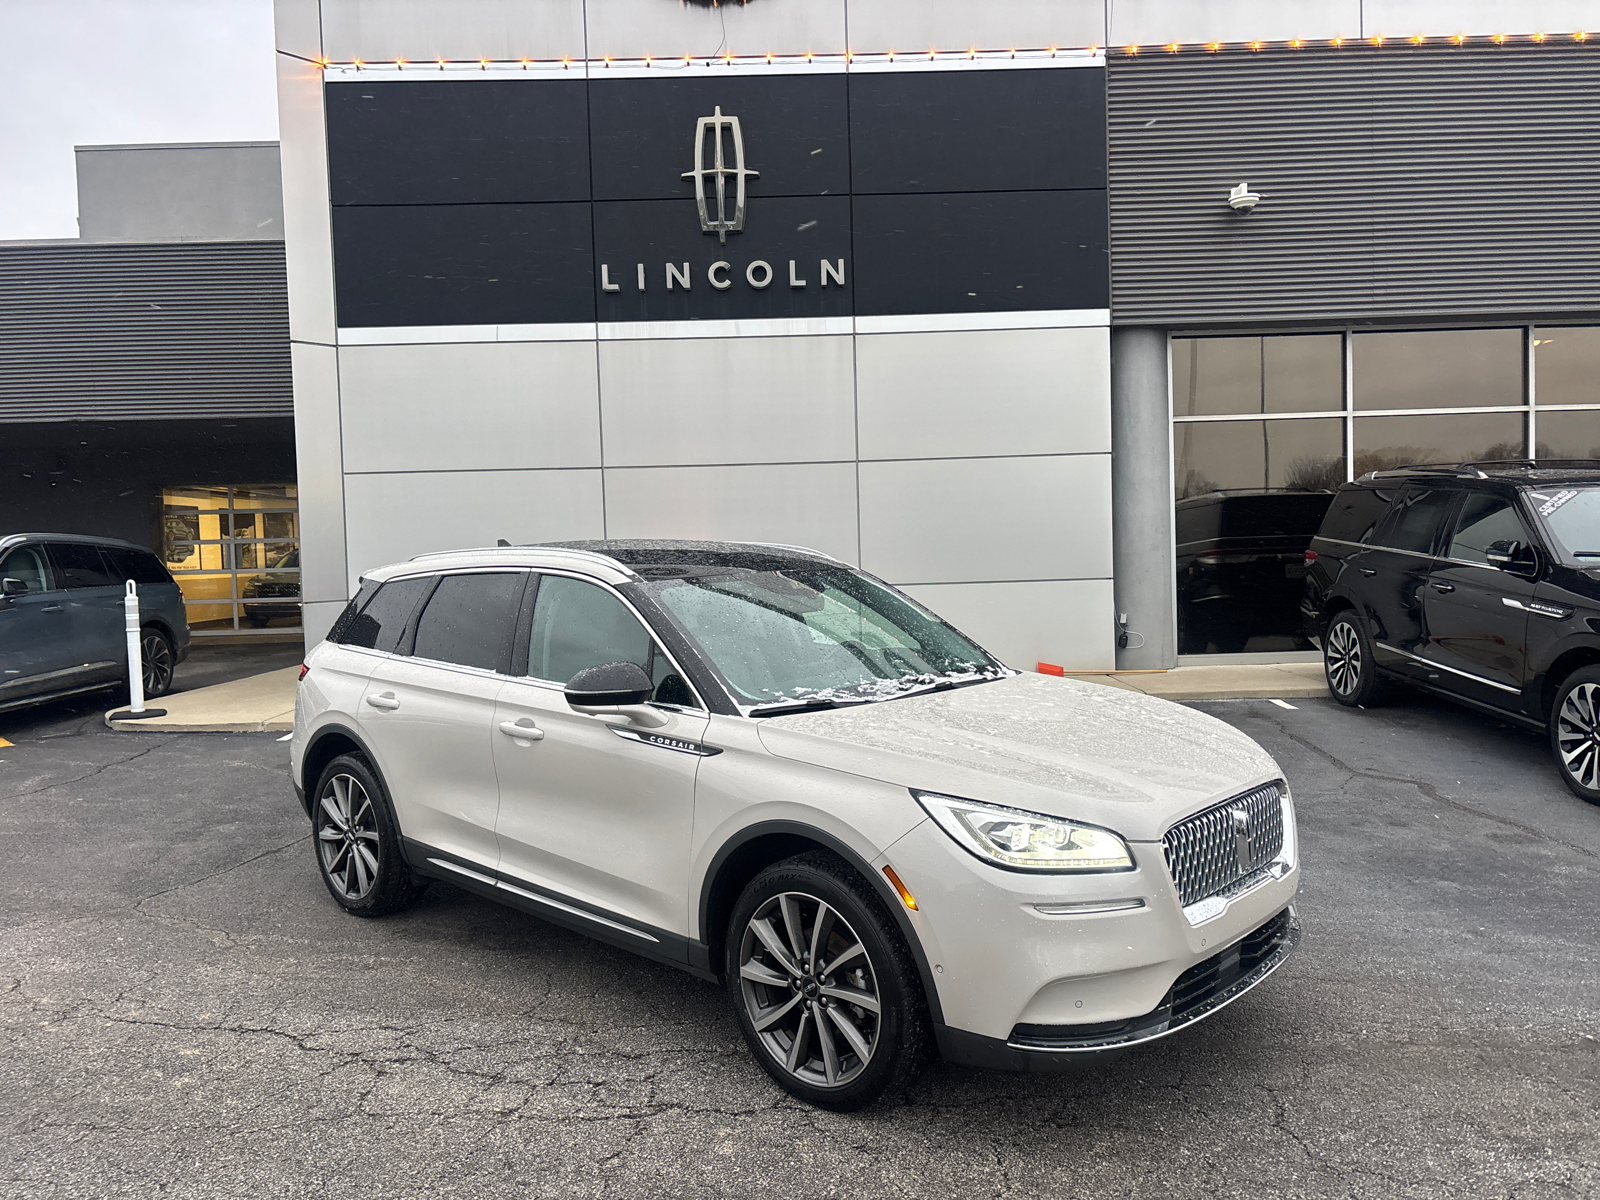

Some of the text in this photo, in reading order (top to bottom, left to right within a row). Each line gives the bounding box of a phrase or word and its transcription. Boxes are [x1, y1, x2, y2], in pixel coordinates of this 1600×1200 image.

[601, 258, 845, 291] LINCOLN
[1538, 490, 1569, 512] CERTIFIED
[649, 736, 695, 750] CORSAIR
